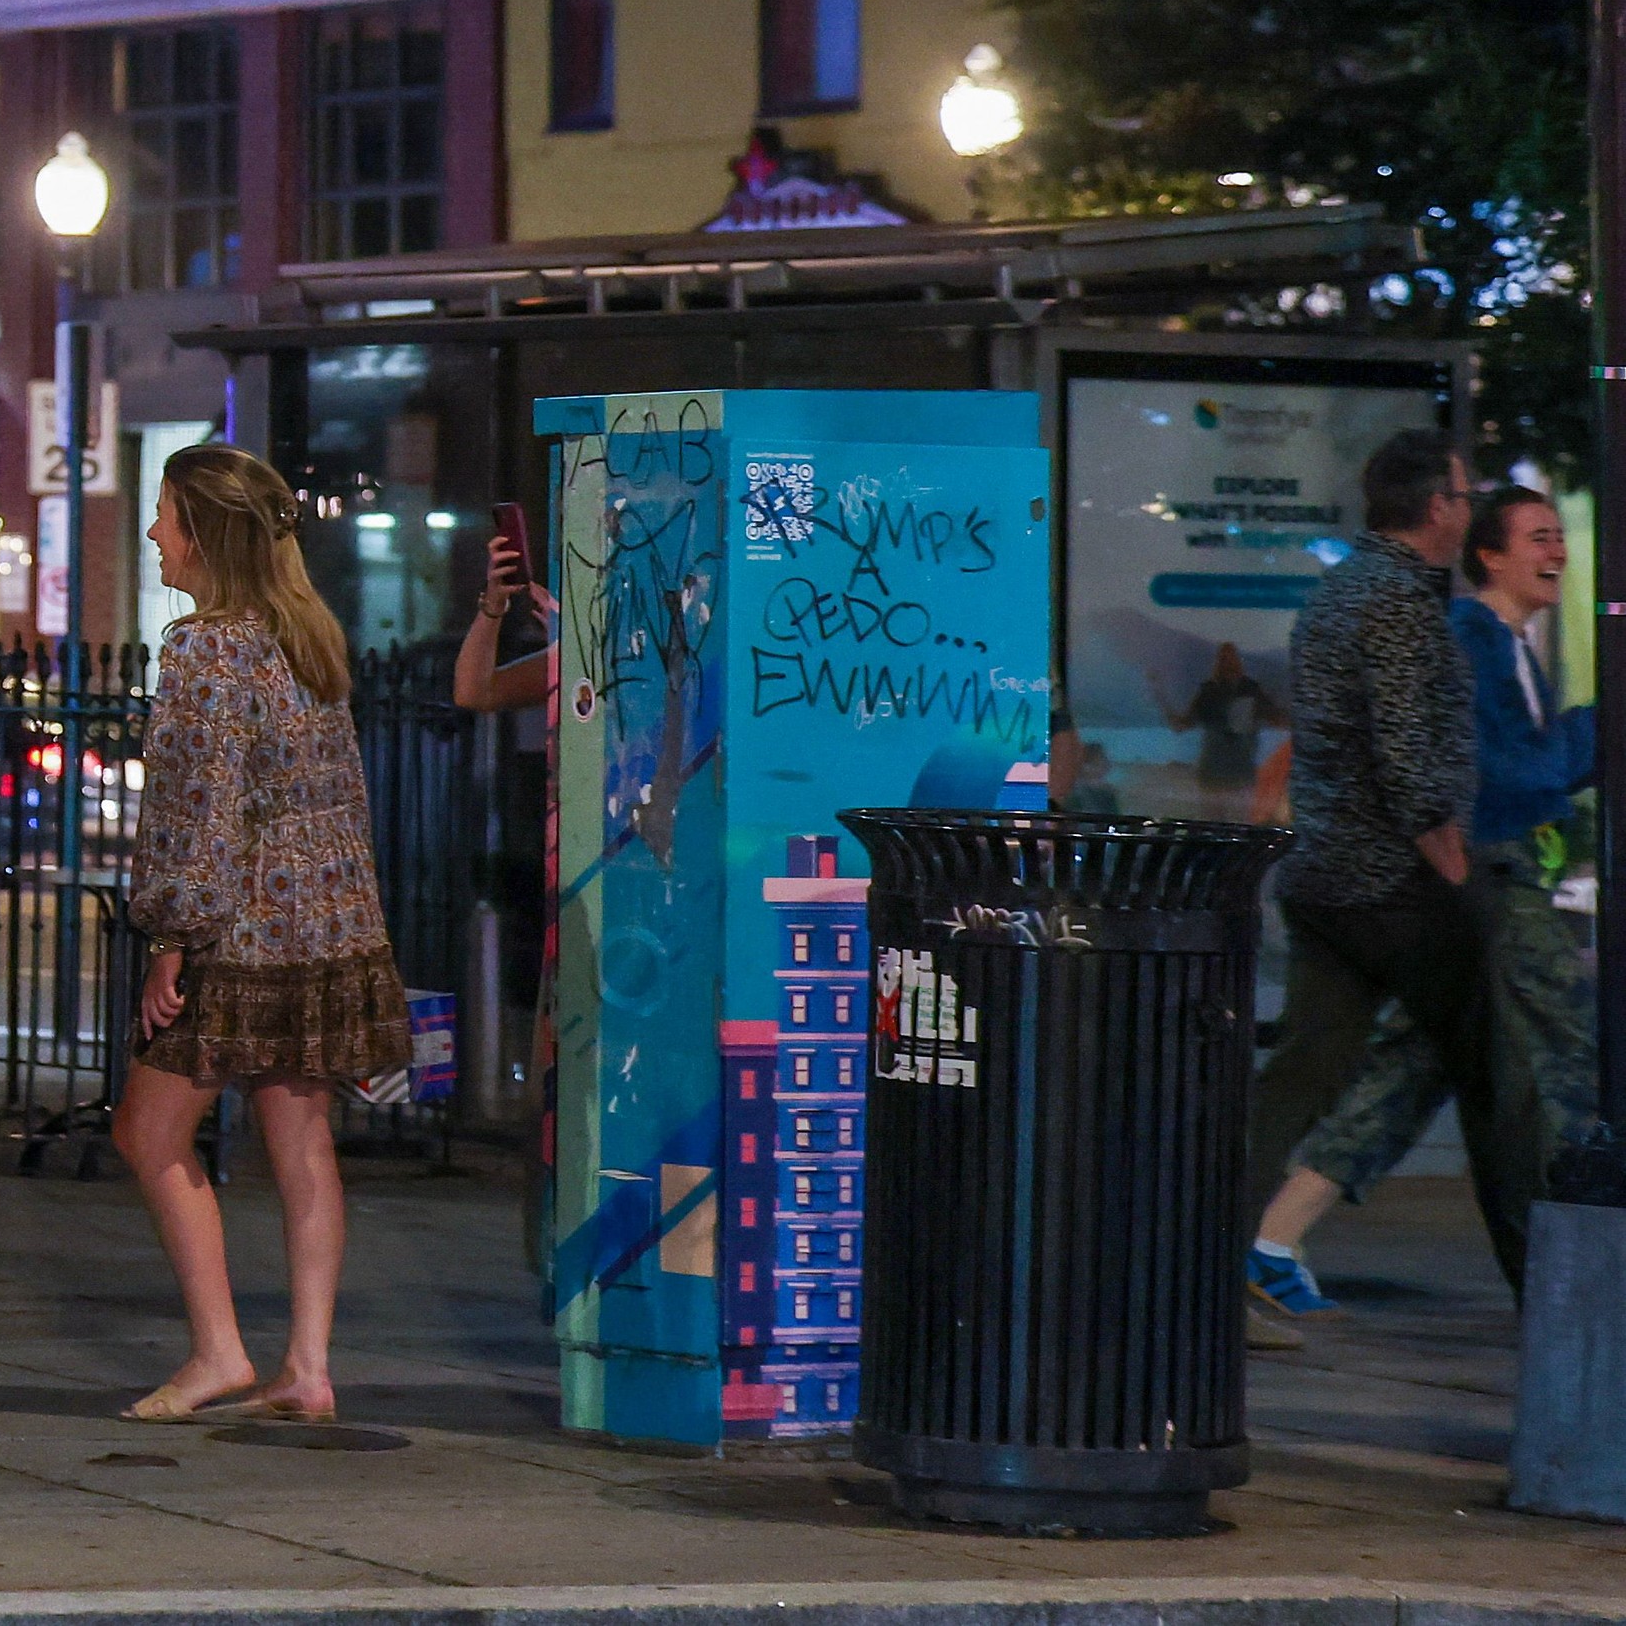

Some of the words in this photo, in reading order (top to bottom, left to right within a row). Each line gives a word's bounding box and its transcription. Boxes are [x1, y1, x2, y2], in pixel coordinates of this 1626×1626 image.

[567, 399, 714, 487] ACAB
[740, 478, 995, 572] TRUMP'S
[847, 545, 889, 596] A
